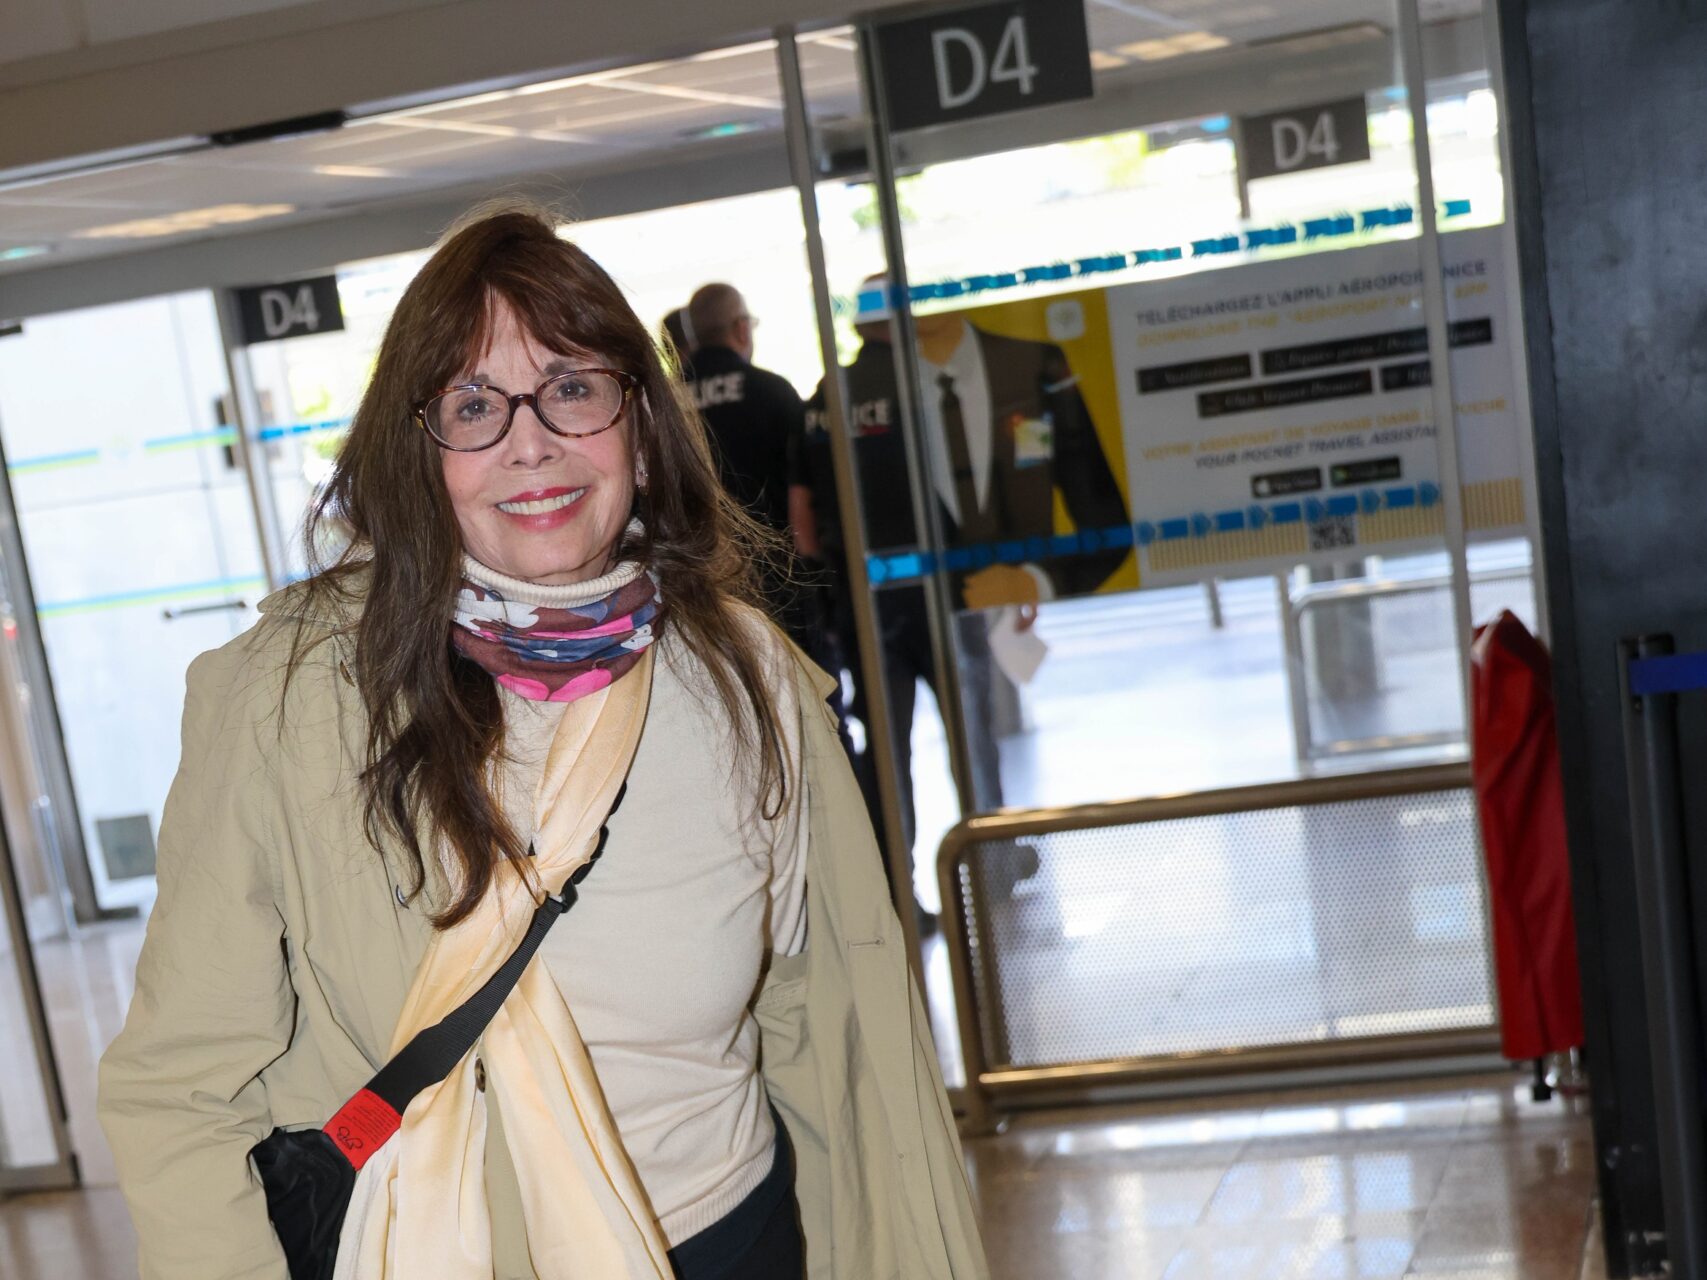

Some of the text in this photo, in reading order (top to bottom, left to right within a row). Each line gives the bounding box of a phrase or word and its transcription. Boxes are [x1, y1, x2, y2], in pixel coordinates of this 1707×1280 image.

[931, 16, 1038, 109] D4
[1271, 111, 1339, 170] D4
[260, 286, 320, 337] D4
